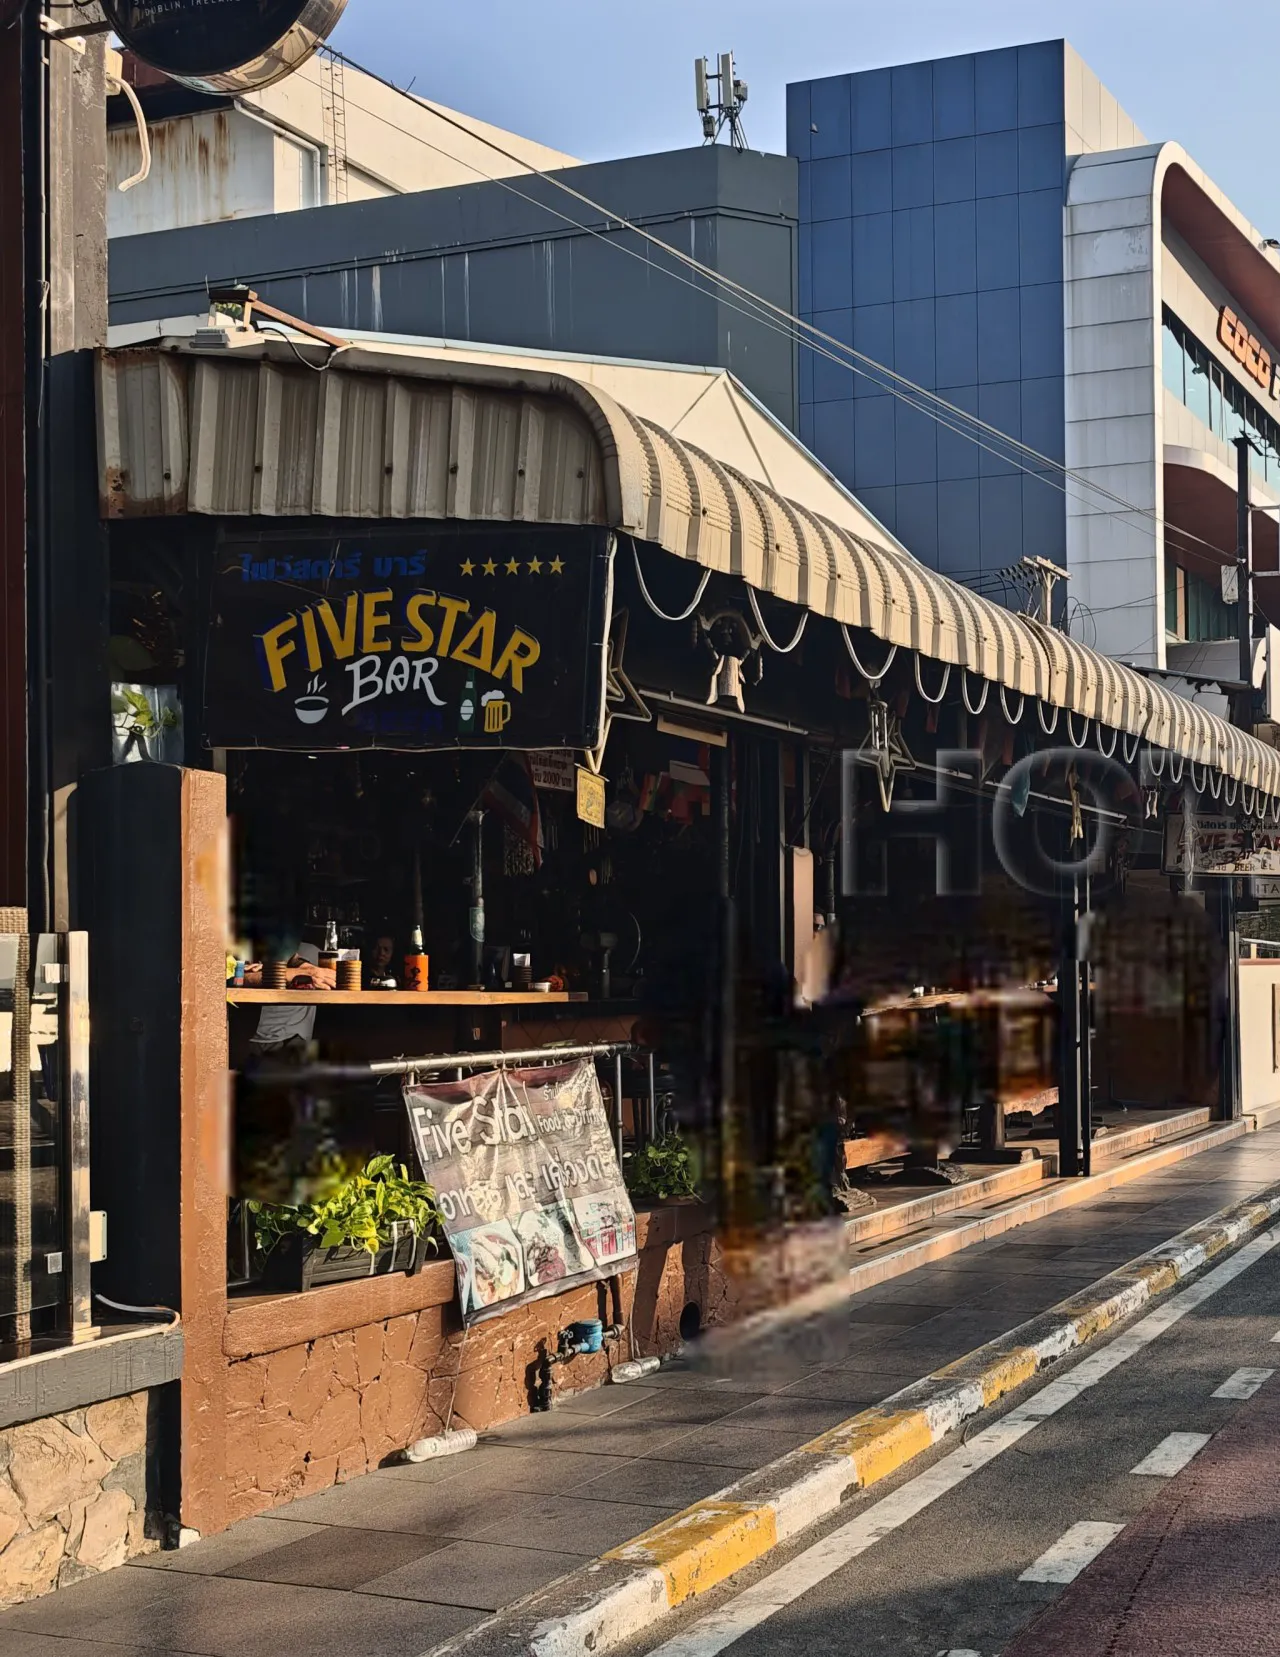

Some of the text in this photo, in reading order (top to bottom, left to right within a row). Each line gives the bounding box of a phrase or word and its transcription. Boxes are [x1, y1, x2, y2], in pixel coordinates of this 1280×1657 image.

[252, 587, 541, 694] FIVE STAR
[341, 655, 448, 716] BAR
[411, 1106, 472, 1161] Five
